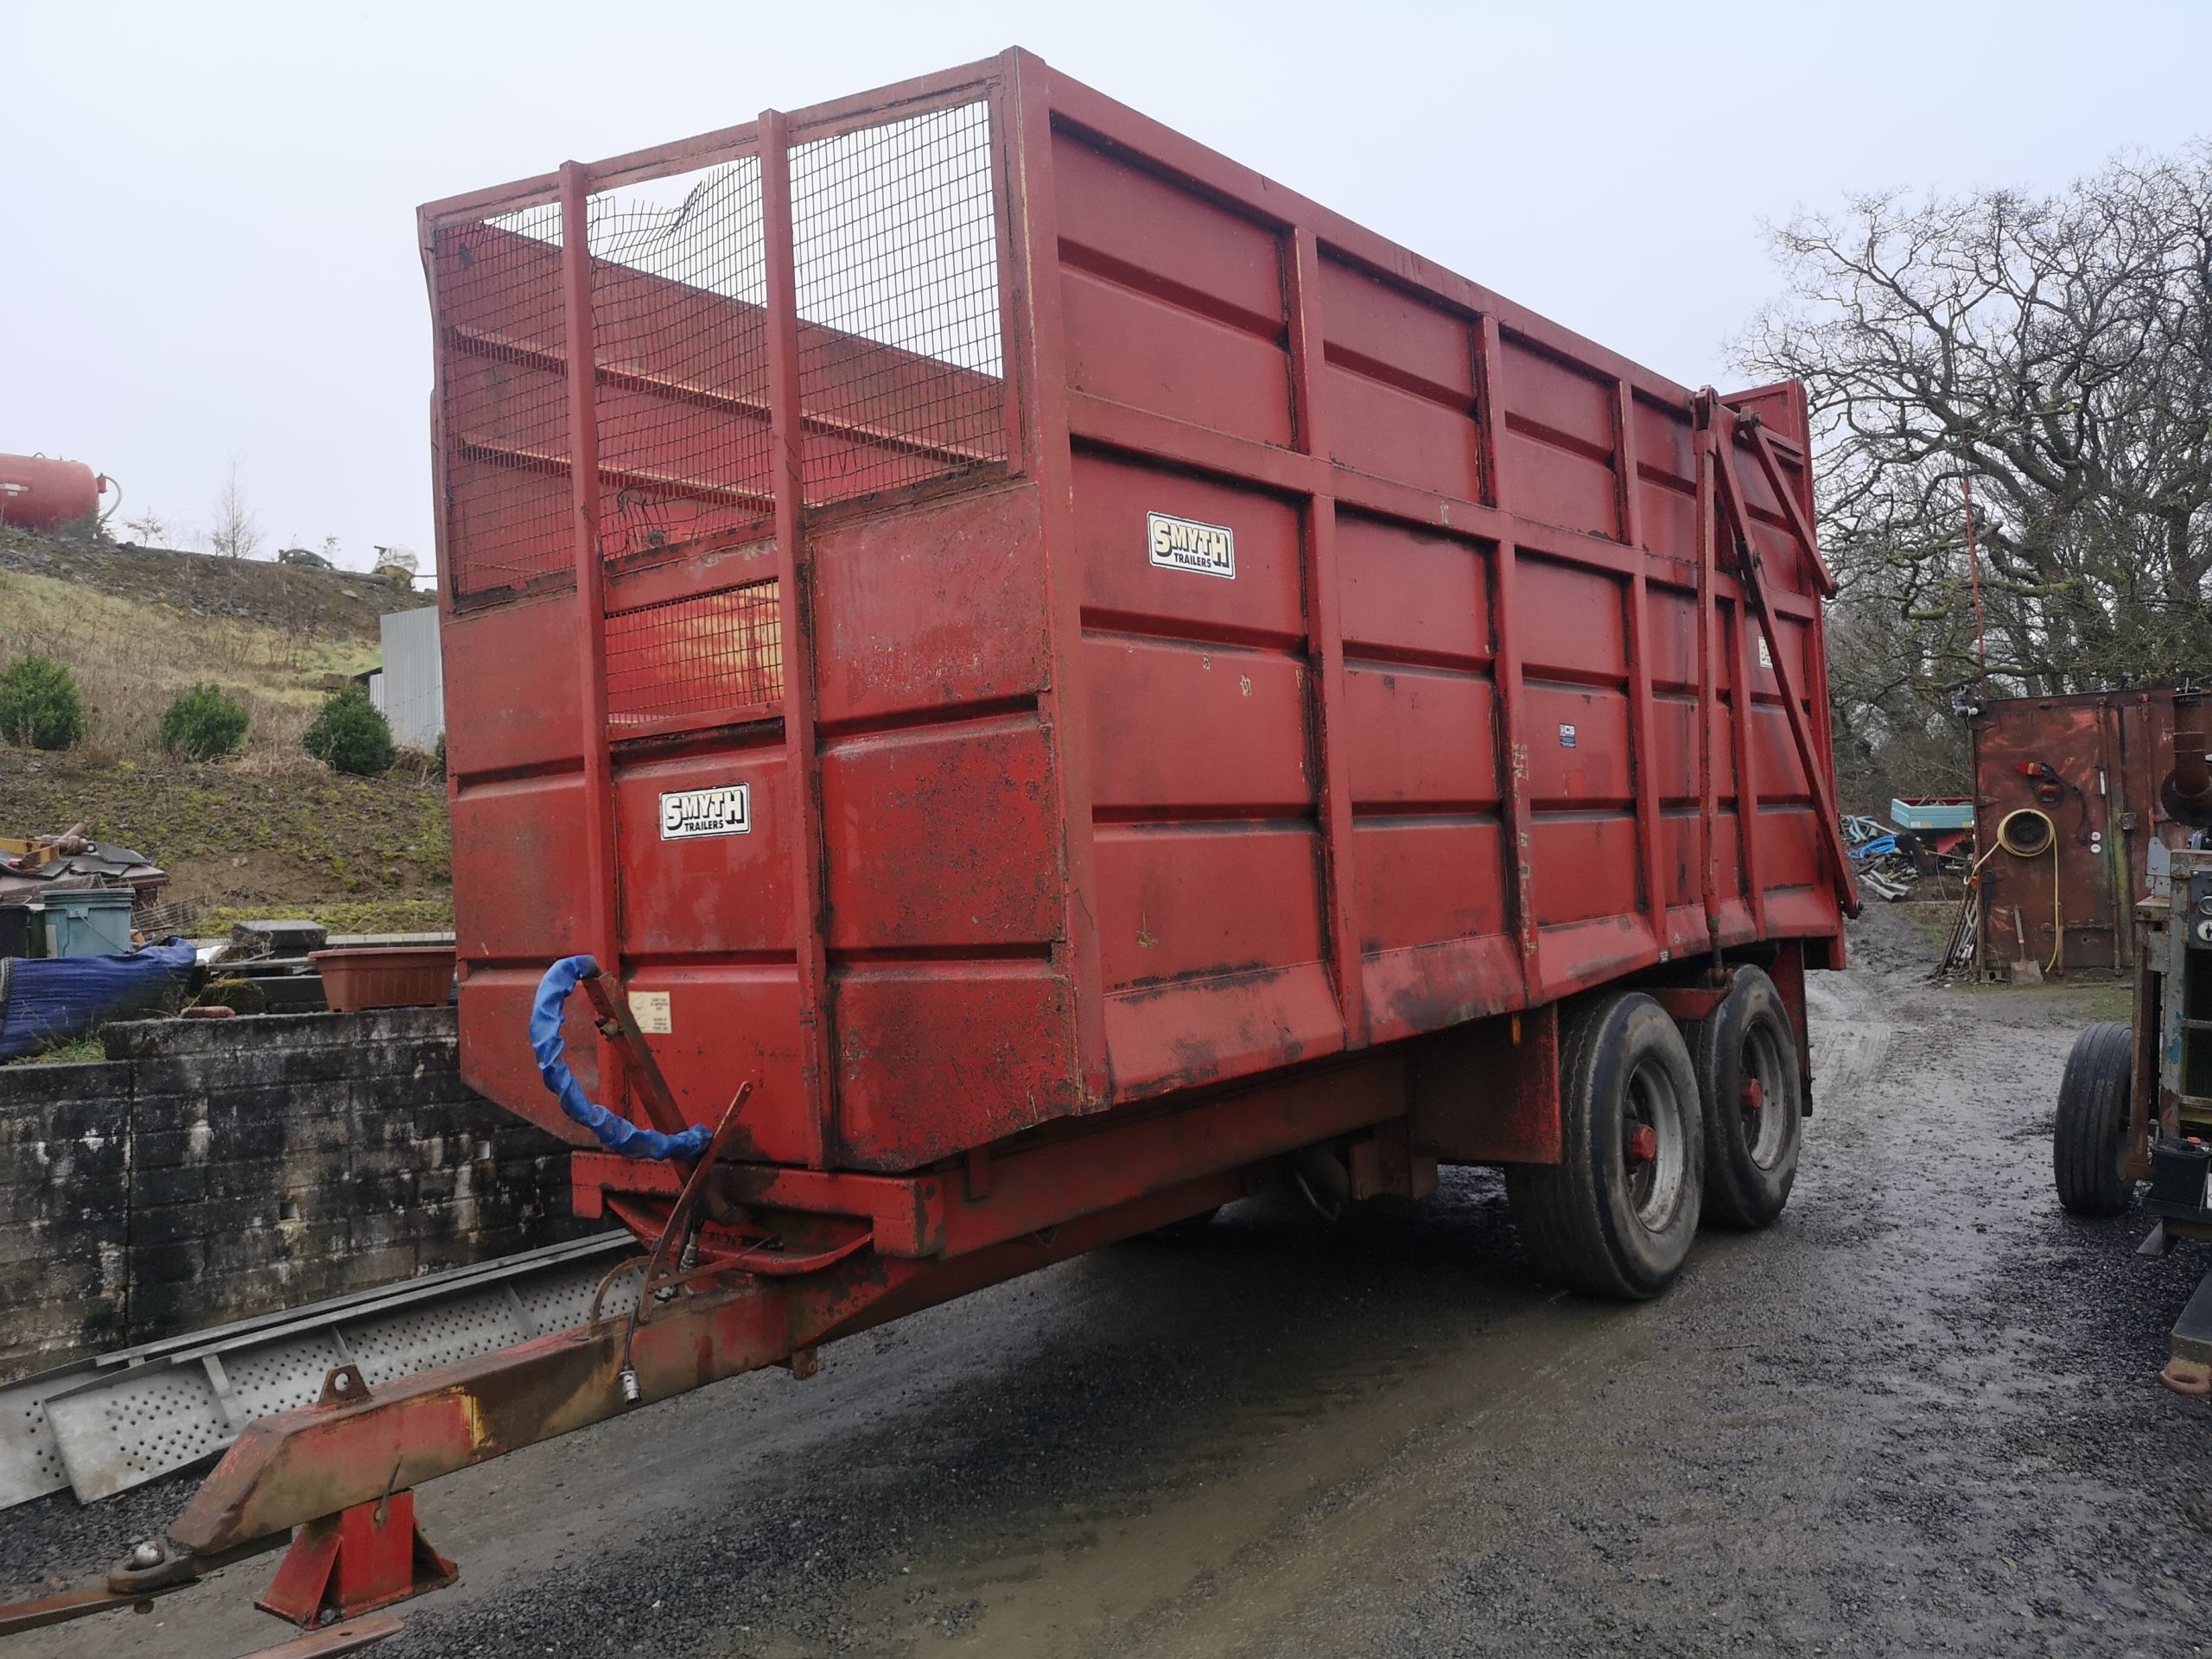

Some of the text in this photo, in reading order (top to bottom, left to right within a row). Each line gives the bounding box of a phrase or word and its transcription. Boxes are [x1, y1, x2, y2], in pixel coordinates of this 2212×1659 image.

[1153, 519, 1230, 569] SMYTH
[1173, 552, 1211, 569] TRAILERS
[664, 789, 745, 830] SMYTH
[684, 819, 724, 832] TRAILERS
